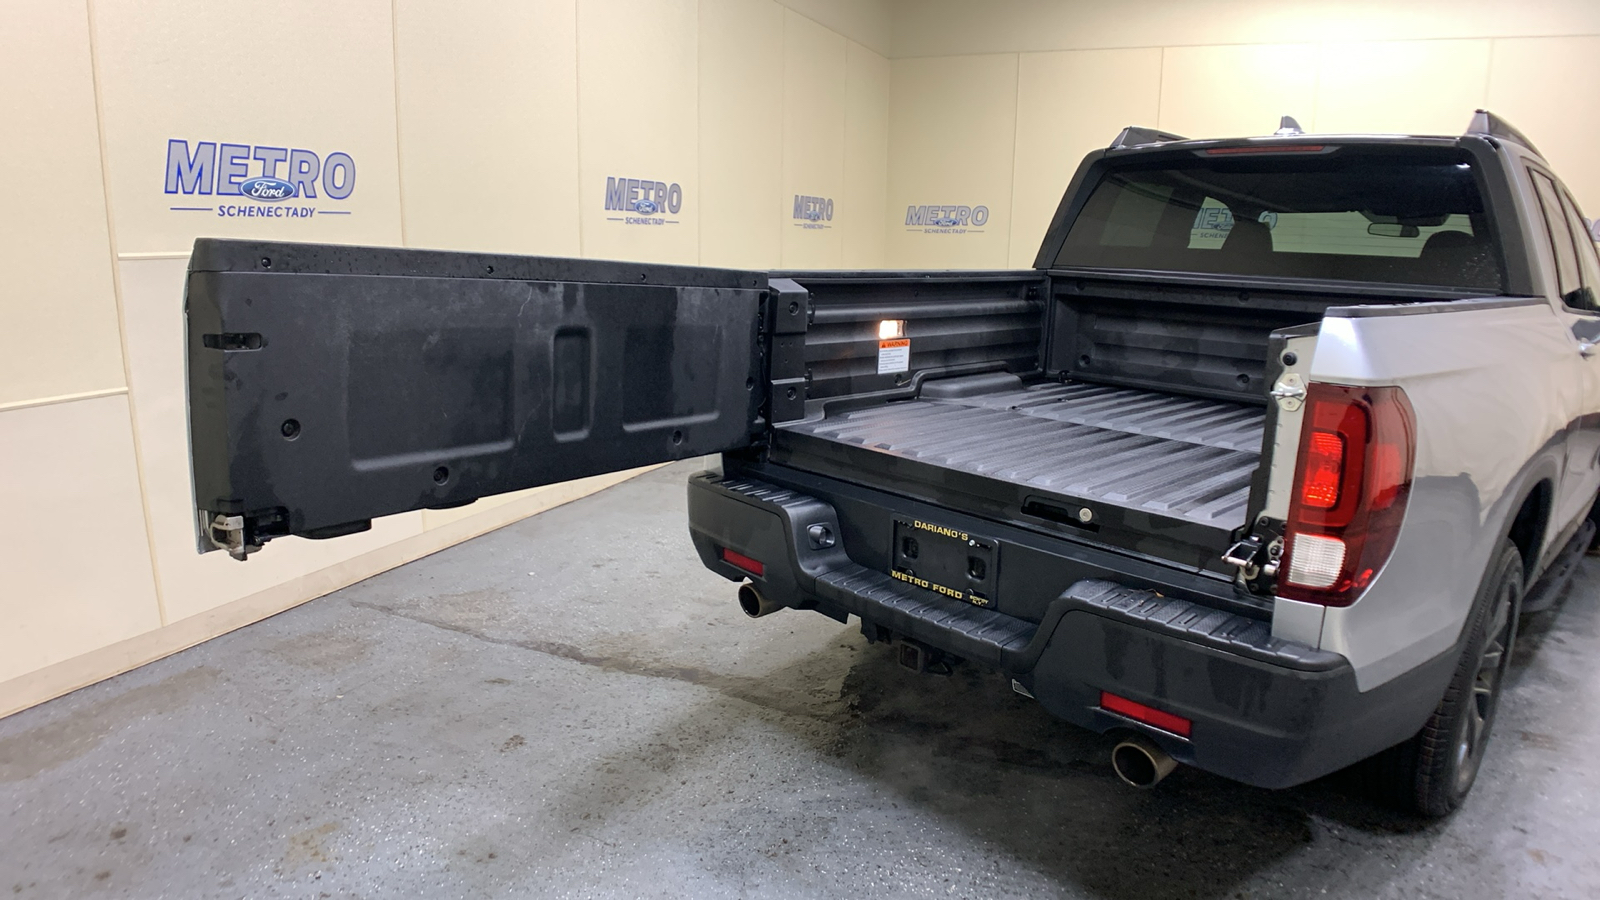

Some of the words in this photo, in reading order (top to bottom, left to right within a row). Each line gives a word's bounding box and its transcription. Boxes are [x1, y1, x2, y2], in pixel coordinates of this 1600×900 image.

[164, 139, 356, 200] METRO
[251, 181, 285, 198] Ford
[605, 176, 682, 214] METRO
[217, 205, 316, 218] SCHENECTADY
[793, 194, 834, 221] METRO
[905, 205, 989, 226] METRO
[914, 520, 968, 541] DARIANO'S
[891, 570, 929, 588] METRO
[932, 583, 962, 599] FORD
